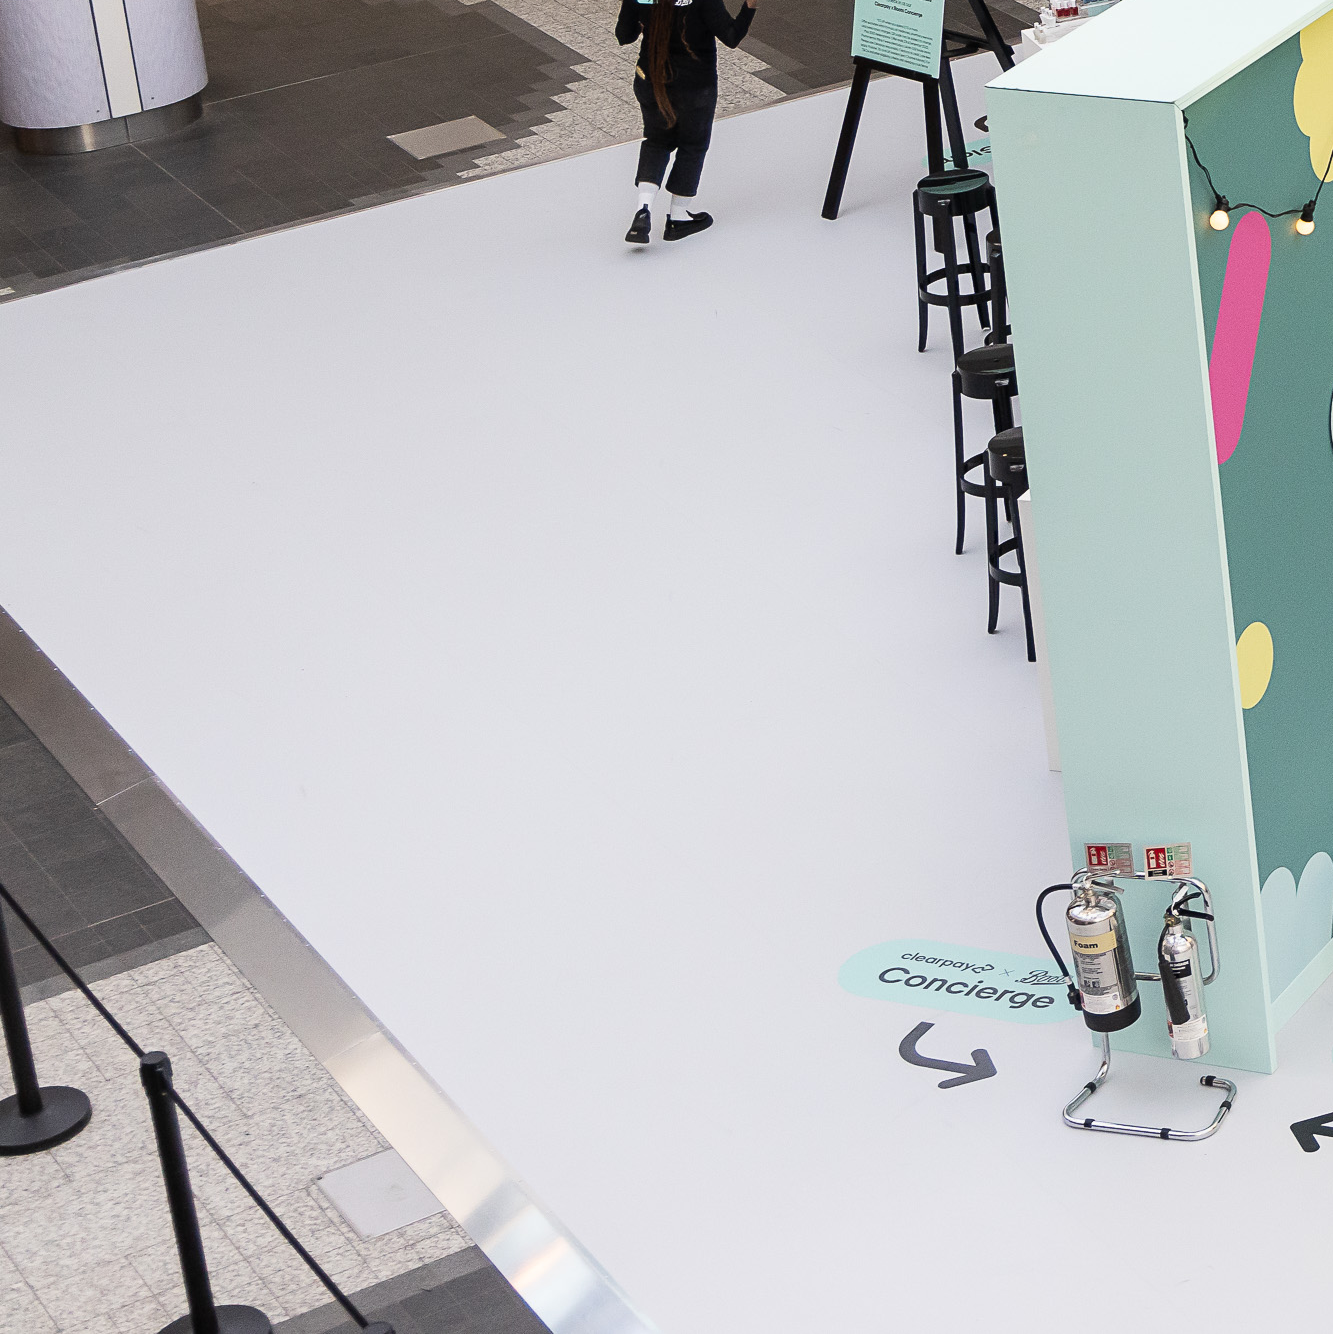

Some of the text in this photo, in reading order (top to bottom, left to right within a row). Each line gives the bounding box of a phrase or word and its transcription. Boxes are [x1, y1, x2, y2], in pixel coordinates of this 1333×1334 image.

[1074, 939, 1098, 949] Foam
[901, 952, 972, 972] clearpay
[878, 967, 1055, 1009] Concierge
